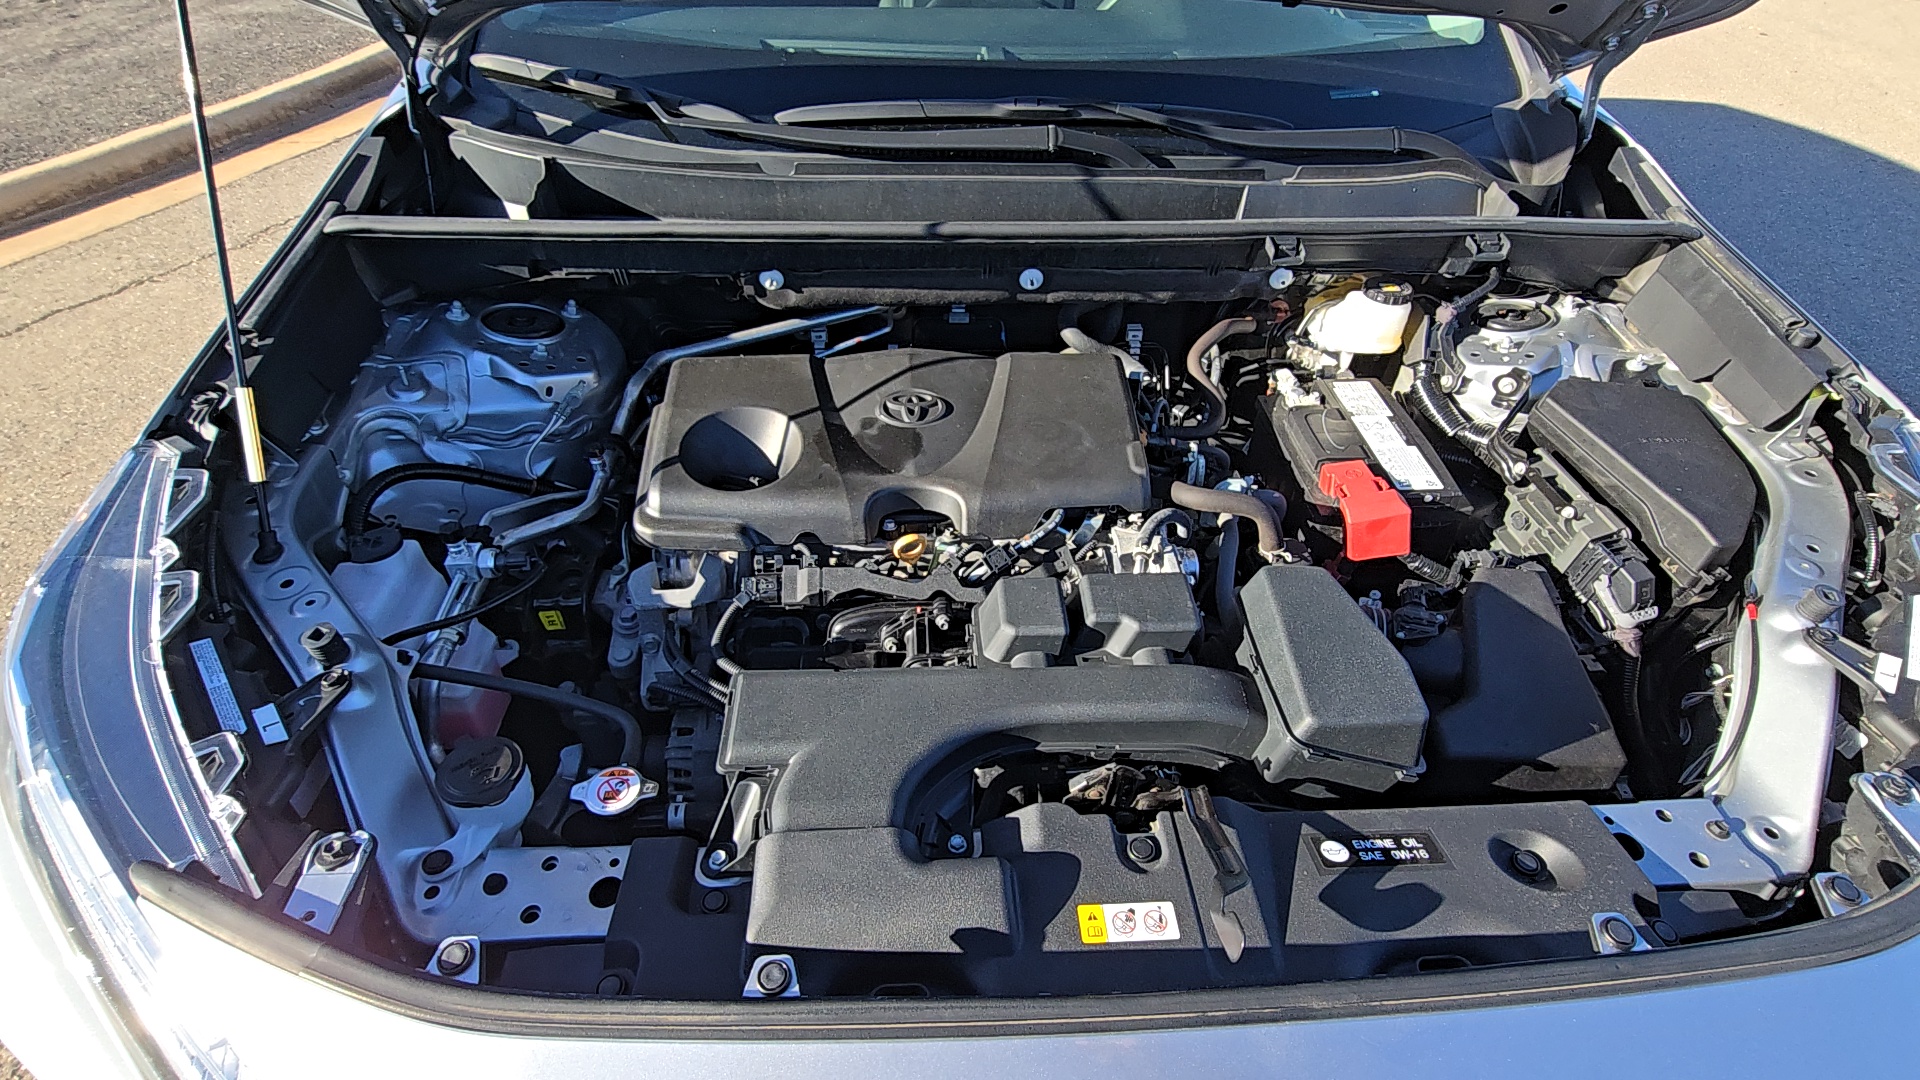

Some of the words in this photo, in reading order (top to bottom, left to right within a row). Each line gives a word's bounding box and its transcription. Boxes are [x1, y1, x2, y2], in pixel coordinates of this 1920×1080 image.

[1352, 839, 1397, 849] ENGINE
[1401, 838, 1424, 848] OIL
[1359, 851, 1385, 860] SAE
[1391, 849, 1430, 859] 0W-16
